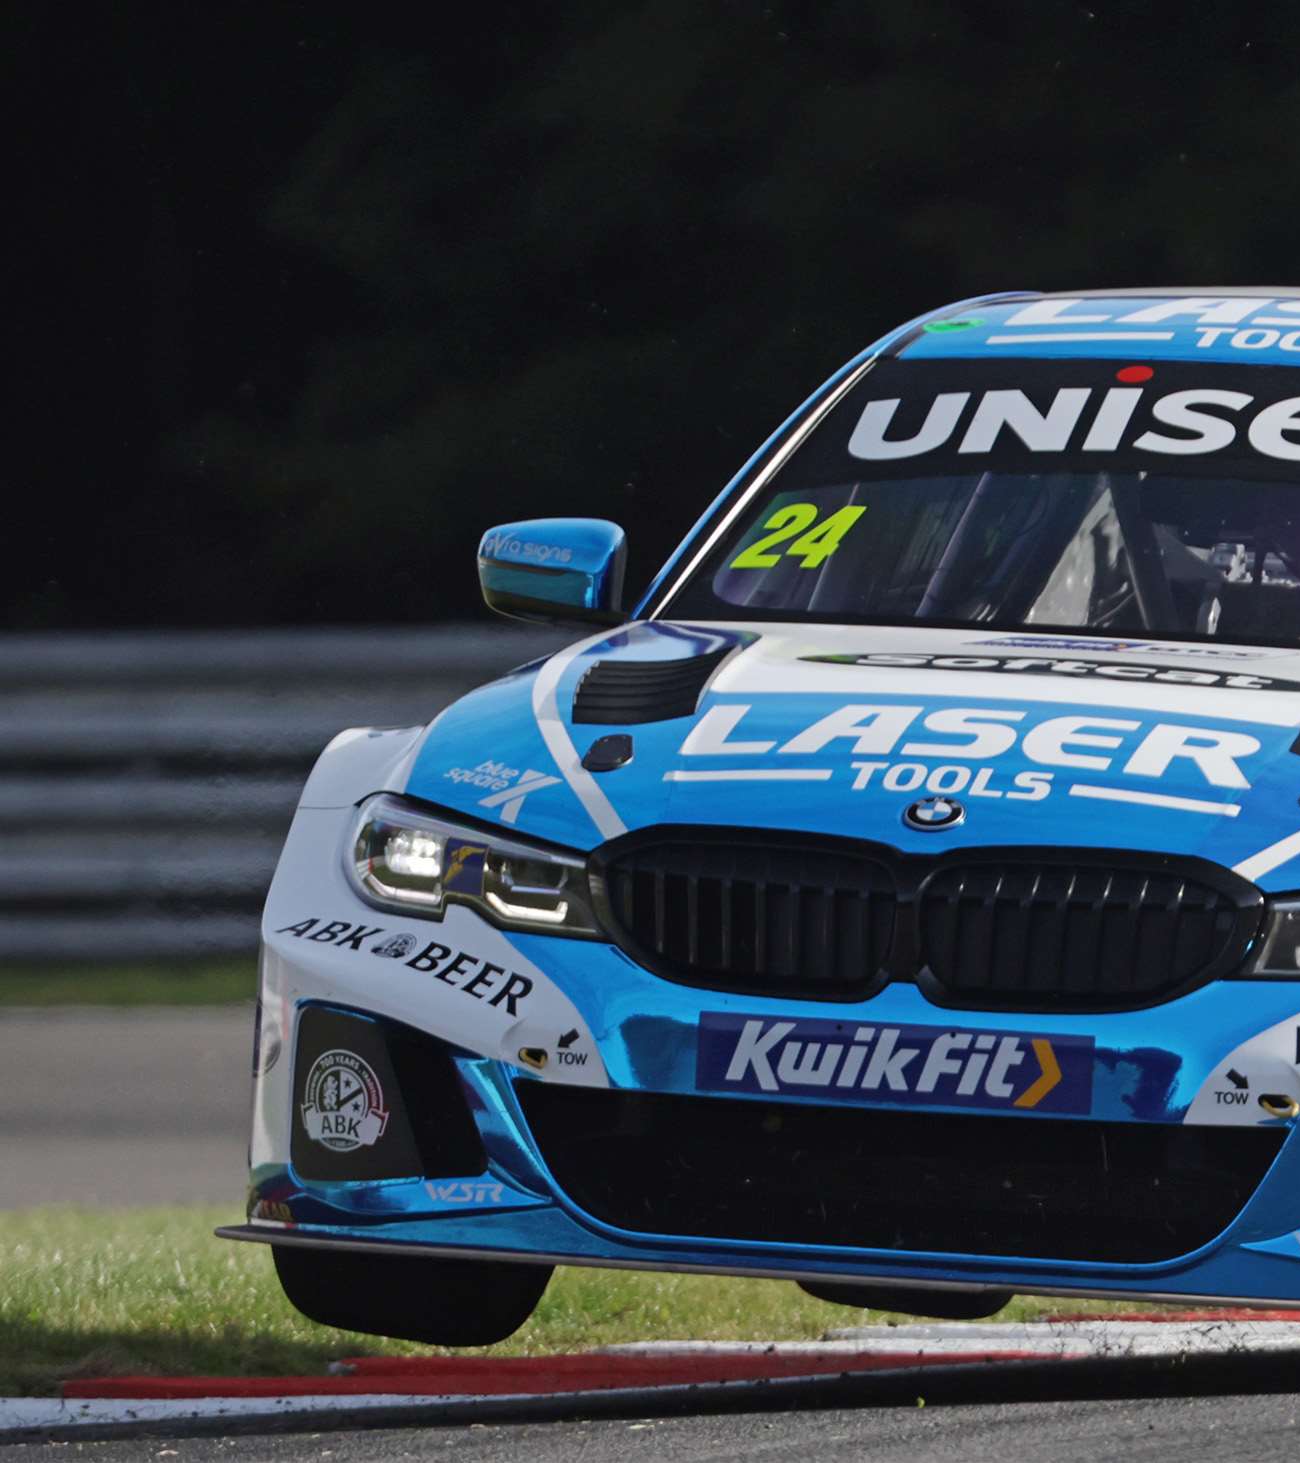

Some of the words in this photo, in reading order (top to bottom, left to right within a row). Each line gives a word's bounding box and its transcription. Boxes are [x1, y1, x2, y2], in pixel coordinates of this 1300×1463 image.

[729, 502, 868, 570] 24
[855, 653, 1273, 690] Softcat
[679, 704, 1262, 790] LASER
[443, 767, 510, 791] square
[474, 759, 520, 780] blue
[851, 760, 1056, 801] TOOLS
[274, 917, 385, 951] ABK
[404, 941, 535, 1017] BEER
[556, 1051, 588, 1067] TOW
[1214, 1090, 1249, 1105] TOW
[321, 1114, 362, 1138] ABK
